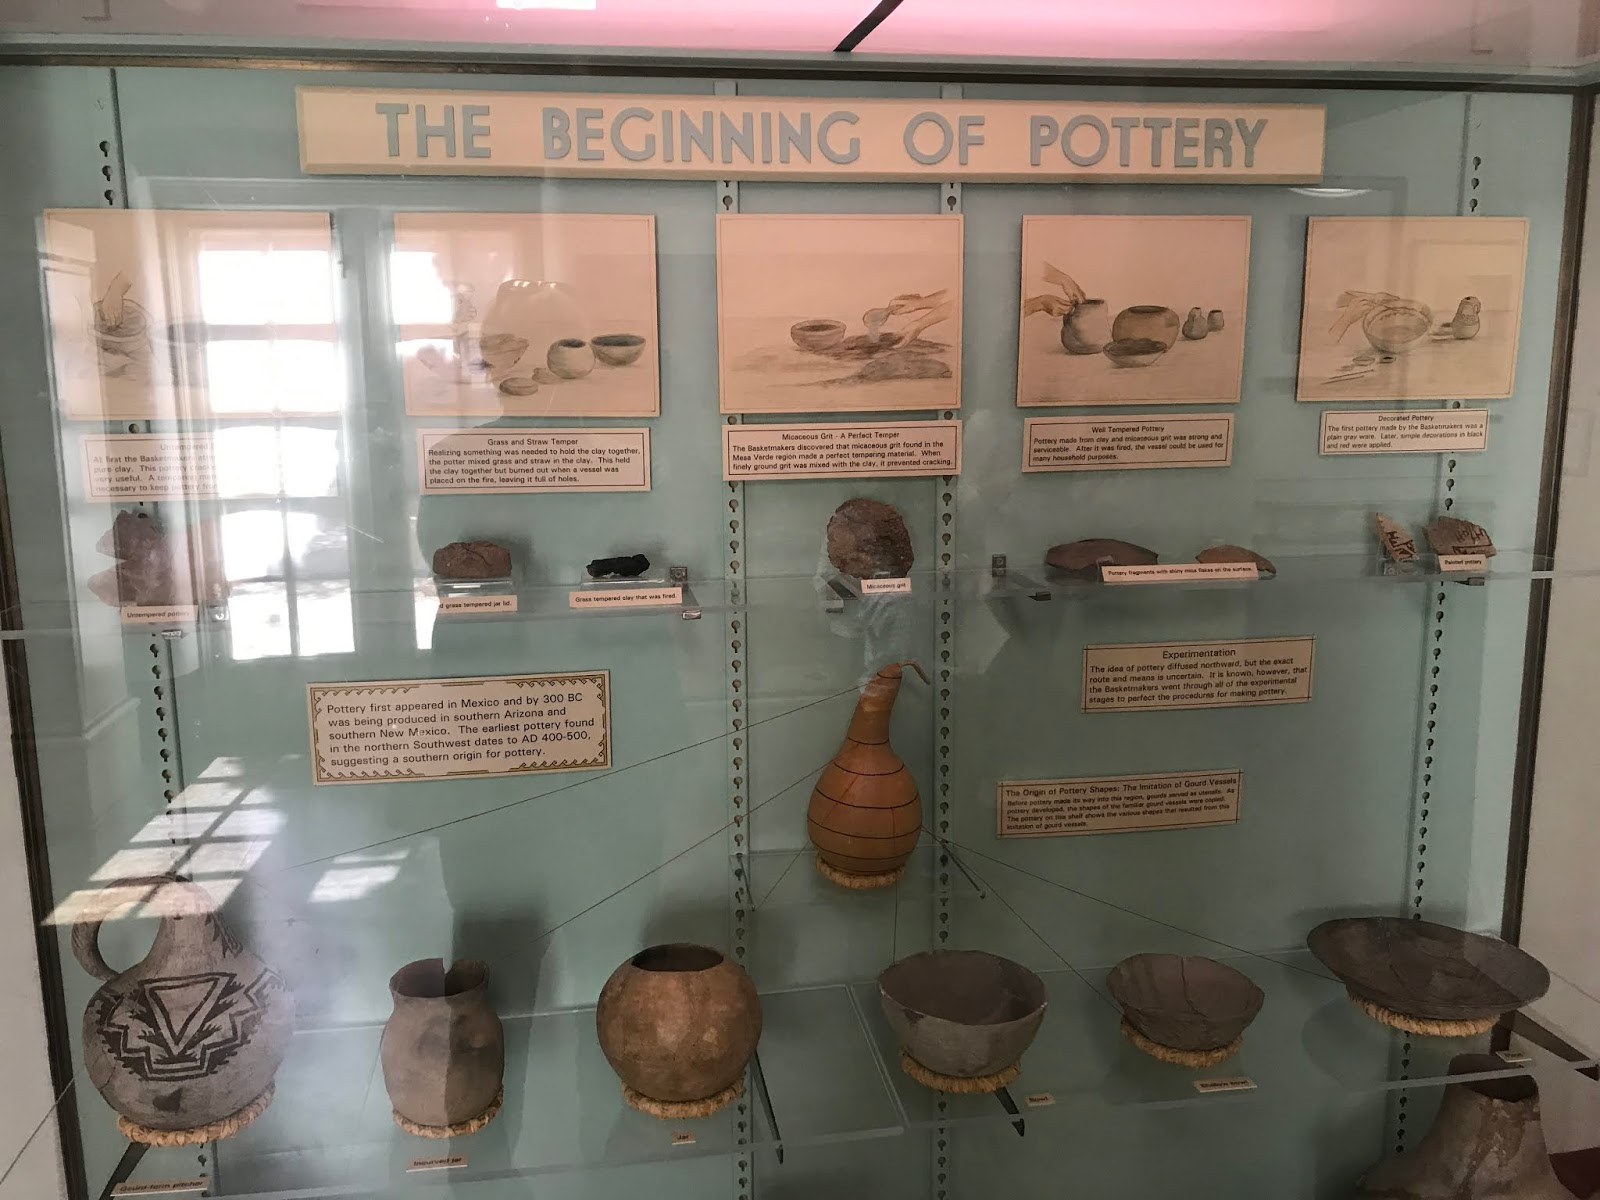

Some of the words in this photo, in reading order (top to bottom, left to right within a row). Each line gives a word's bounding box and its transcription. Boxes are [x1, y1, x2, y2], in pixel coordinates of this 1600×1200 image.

[375, 103, 491, 158] THE
[542, 108, 860, 165] BEGINNING
[903, 111, 985, 166] OF
[1029, 109, 1267, 170] POTTERY
[875, 431, 899, 439] Temper
[552, 438, 578, 446] Temper
[747, 444, 795, 452] Basketmakers
[732, 463, 752, 471] finely
[753, 463, 777, 471] ground
[127, 611, 166, 619] Untempered
[1162, 649, 1236, 659] Experimentation
[1091, 665, 1105, 673] The
[1125, 664, 1134, 672] of
[1136, 664, 1165, 672] pottery
[1166, 661, 1198, 670] diffused
[1200, 660, 1242, 668] northward,
[327, 703, 366, 714] Pottery
[370, 702, 391, 712] first
[395, 700, 444, 712] appeared
[447, 699, 457, 708] in
[460, 697, 499, 708] Mexico
[503, 695, 523, 706] and
[526, 695, 539, 706] by
[543, 693, 564, 703] 300
[567, 692, 582, 702] BC
[328, 719, 350, 727] was
[354, 716, 383, 728] being
[386, 714, 436, 726] produced
[440, 713, 449, 722] in
[453, 711, 500, 721] southern
[503, 708, 543, 718] Arizona
[547, 706, 566, 716] and
[328, 730, 375, 740] southern
[379, 728, 404, 738] New
[408, 726, 450, 736] Mexico.
[458, 724, 478, 734] The
[481, 722, 520, 733] earliest
[523, 721, 561, 732] pottery
[564, 718, 594, 728] found
[343, 743, 360, 752] the
[364, 742, 409, 752] northern
[413, 738, 470, 749] Southwest
[474, 736, 503, 746] dates
[507, 736, 518, 744] to
[521, 733, 538, 743] AD
[541, 731, 590, 742] 400-500,
[330, 756, 389, 768] suggesting
[402, 753, 449, 763] southern
[452, 750, 482, 762] origin
[486, 749, 500, 758] for
[504, 748, 545, 758] pottery.
